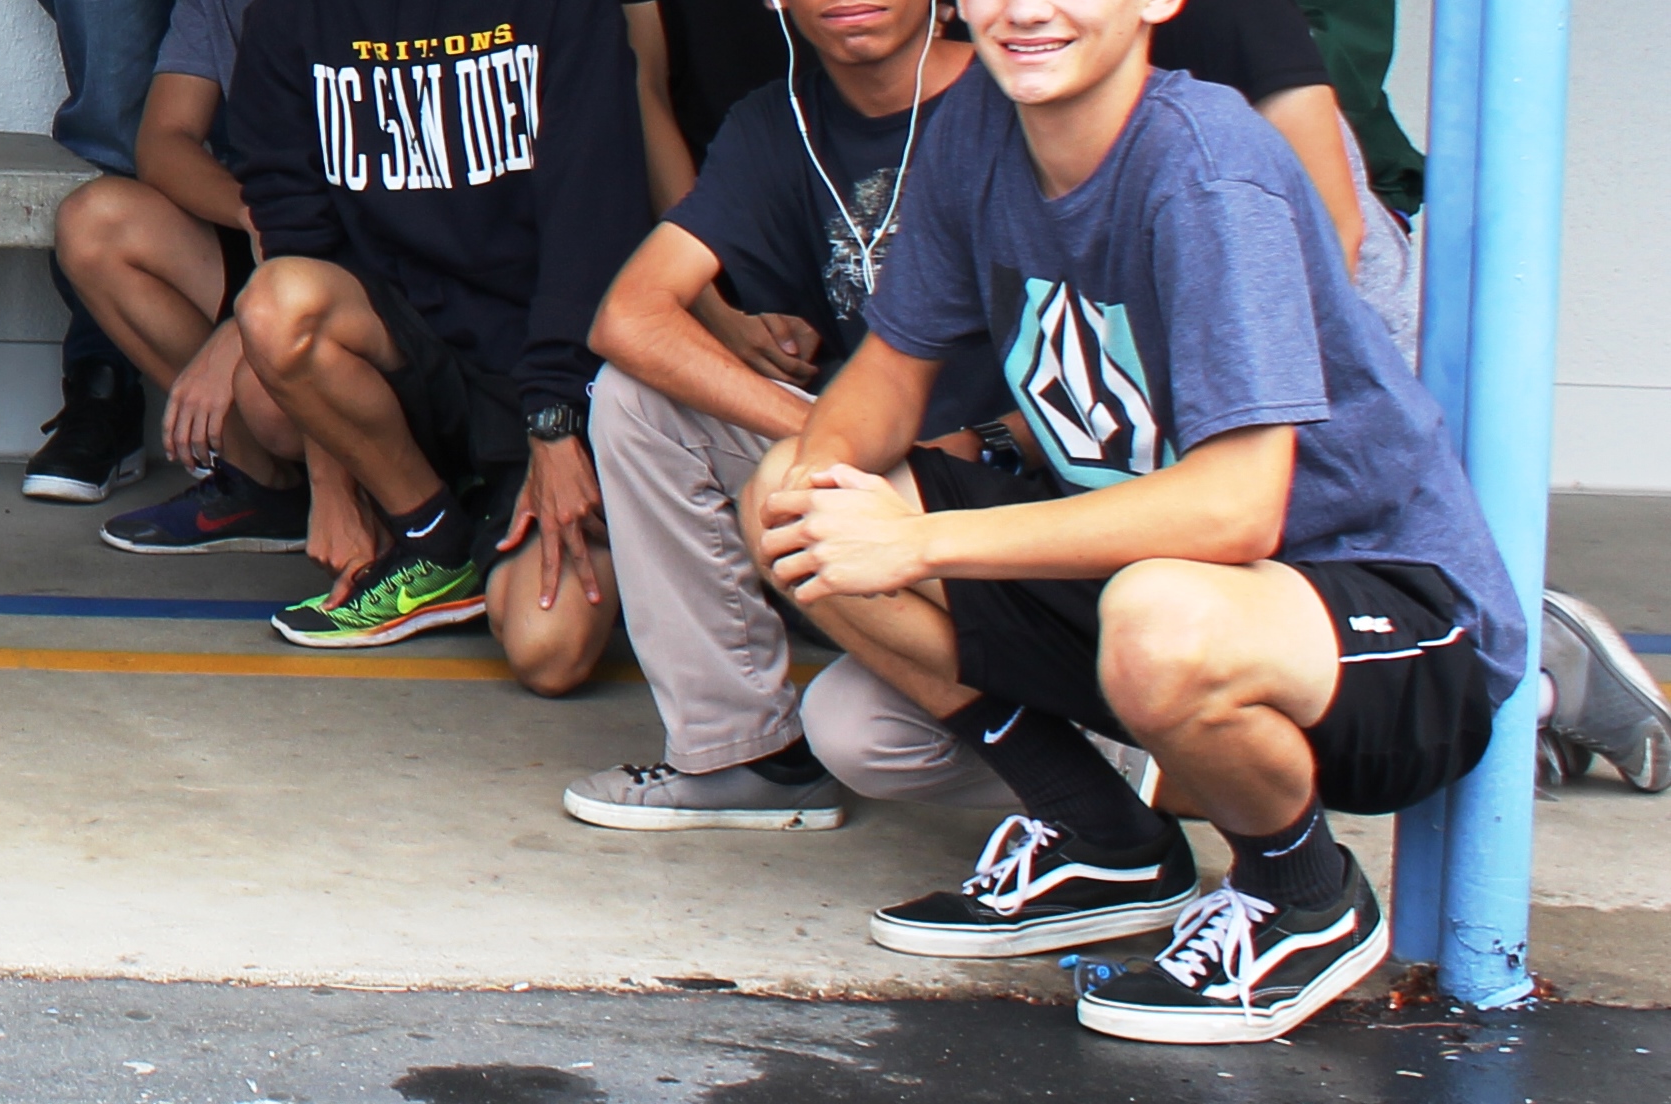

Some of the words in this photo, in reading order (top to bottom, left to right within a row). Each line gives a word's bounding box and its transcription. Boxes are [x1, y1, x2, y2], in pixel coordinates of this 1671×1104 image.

[352, 23, 515, 61] TRITONS
[313, 62, 368, 191] UC
[373, 63, 453, 191] SAN
